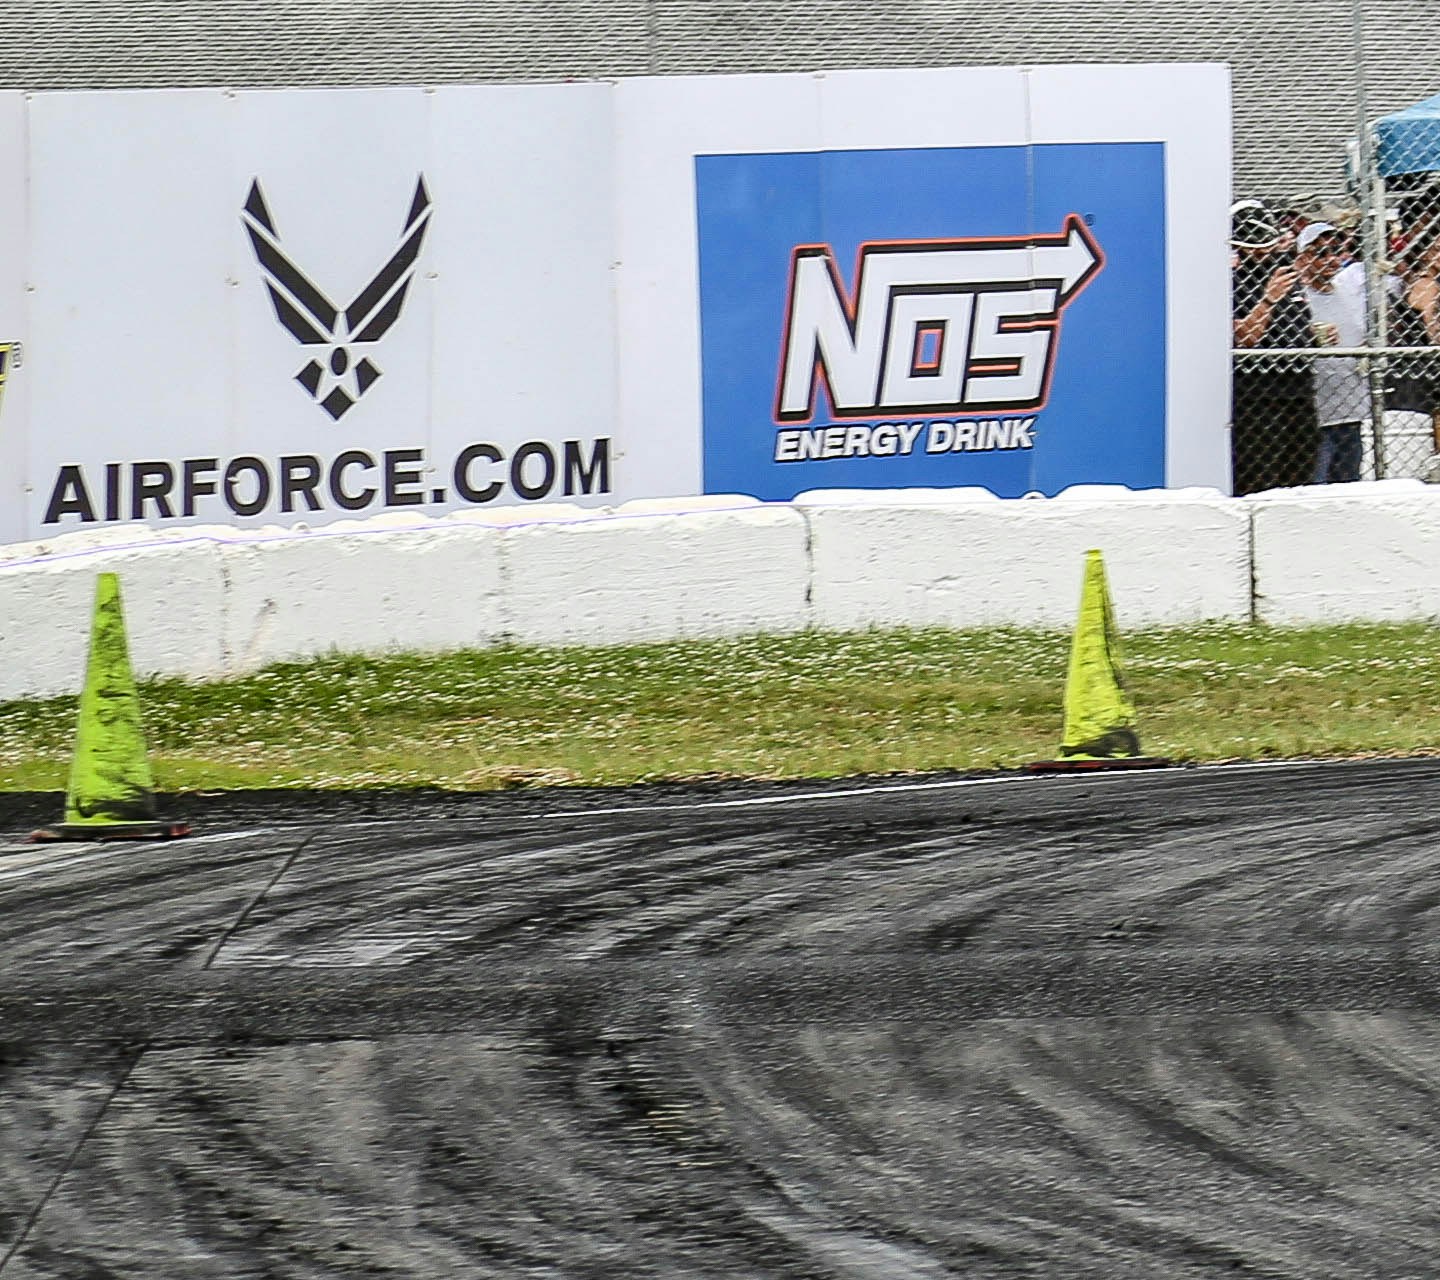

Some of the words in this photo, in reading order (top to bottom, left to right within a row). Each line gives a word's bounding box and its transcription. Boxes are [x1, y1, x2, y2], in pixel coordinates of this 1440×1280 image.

[774, 214, 1105, 424] NOS
[43, 437, 612, 523] AIRFORCE.COM
[774, 423, 925, 463] ENERGY
[925, 416, 1037, 453] DRINK
